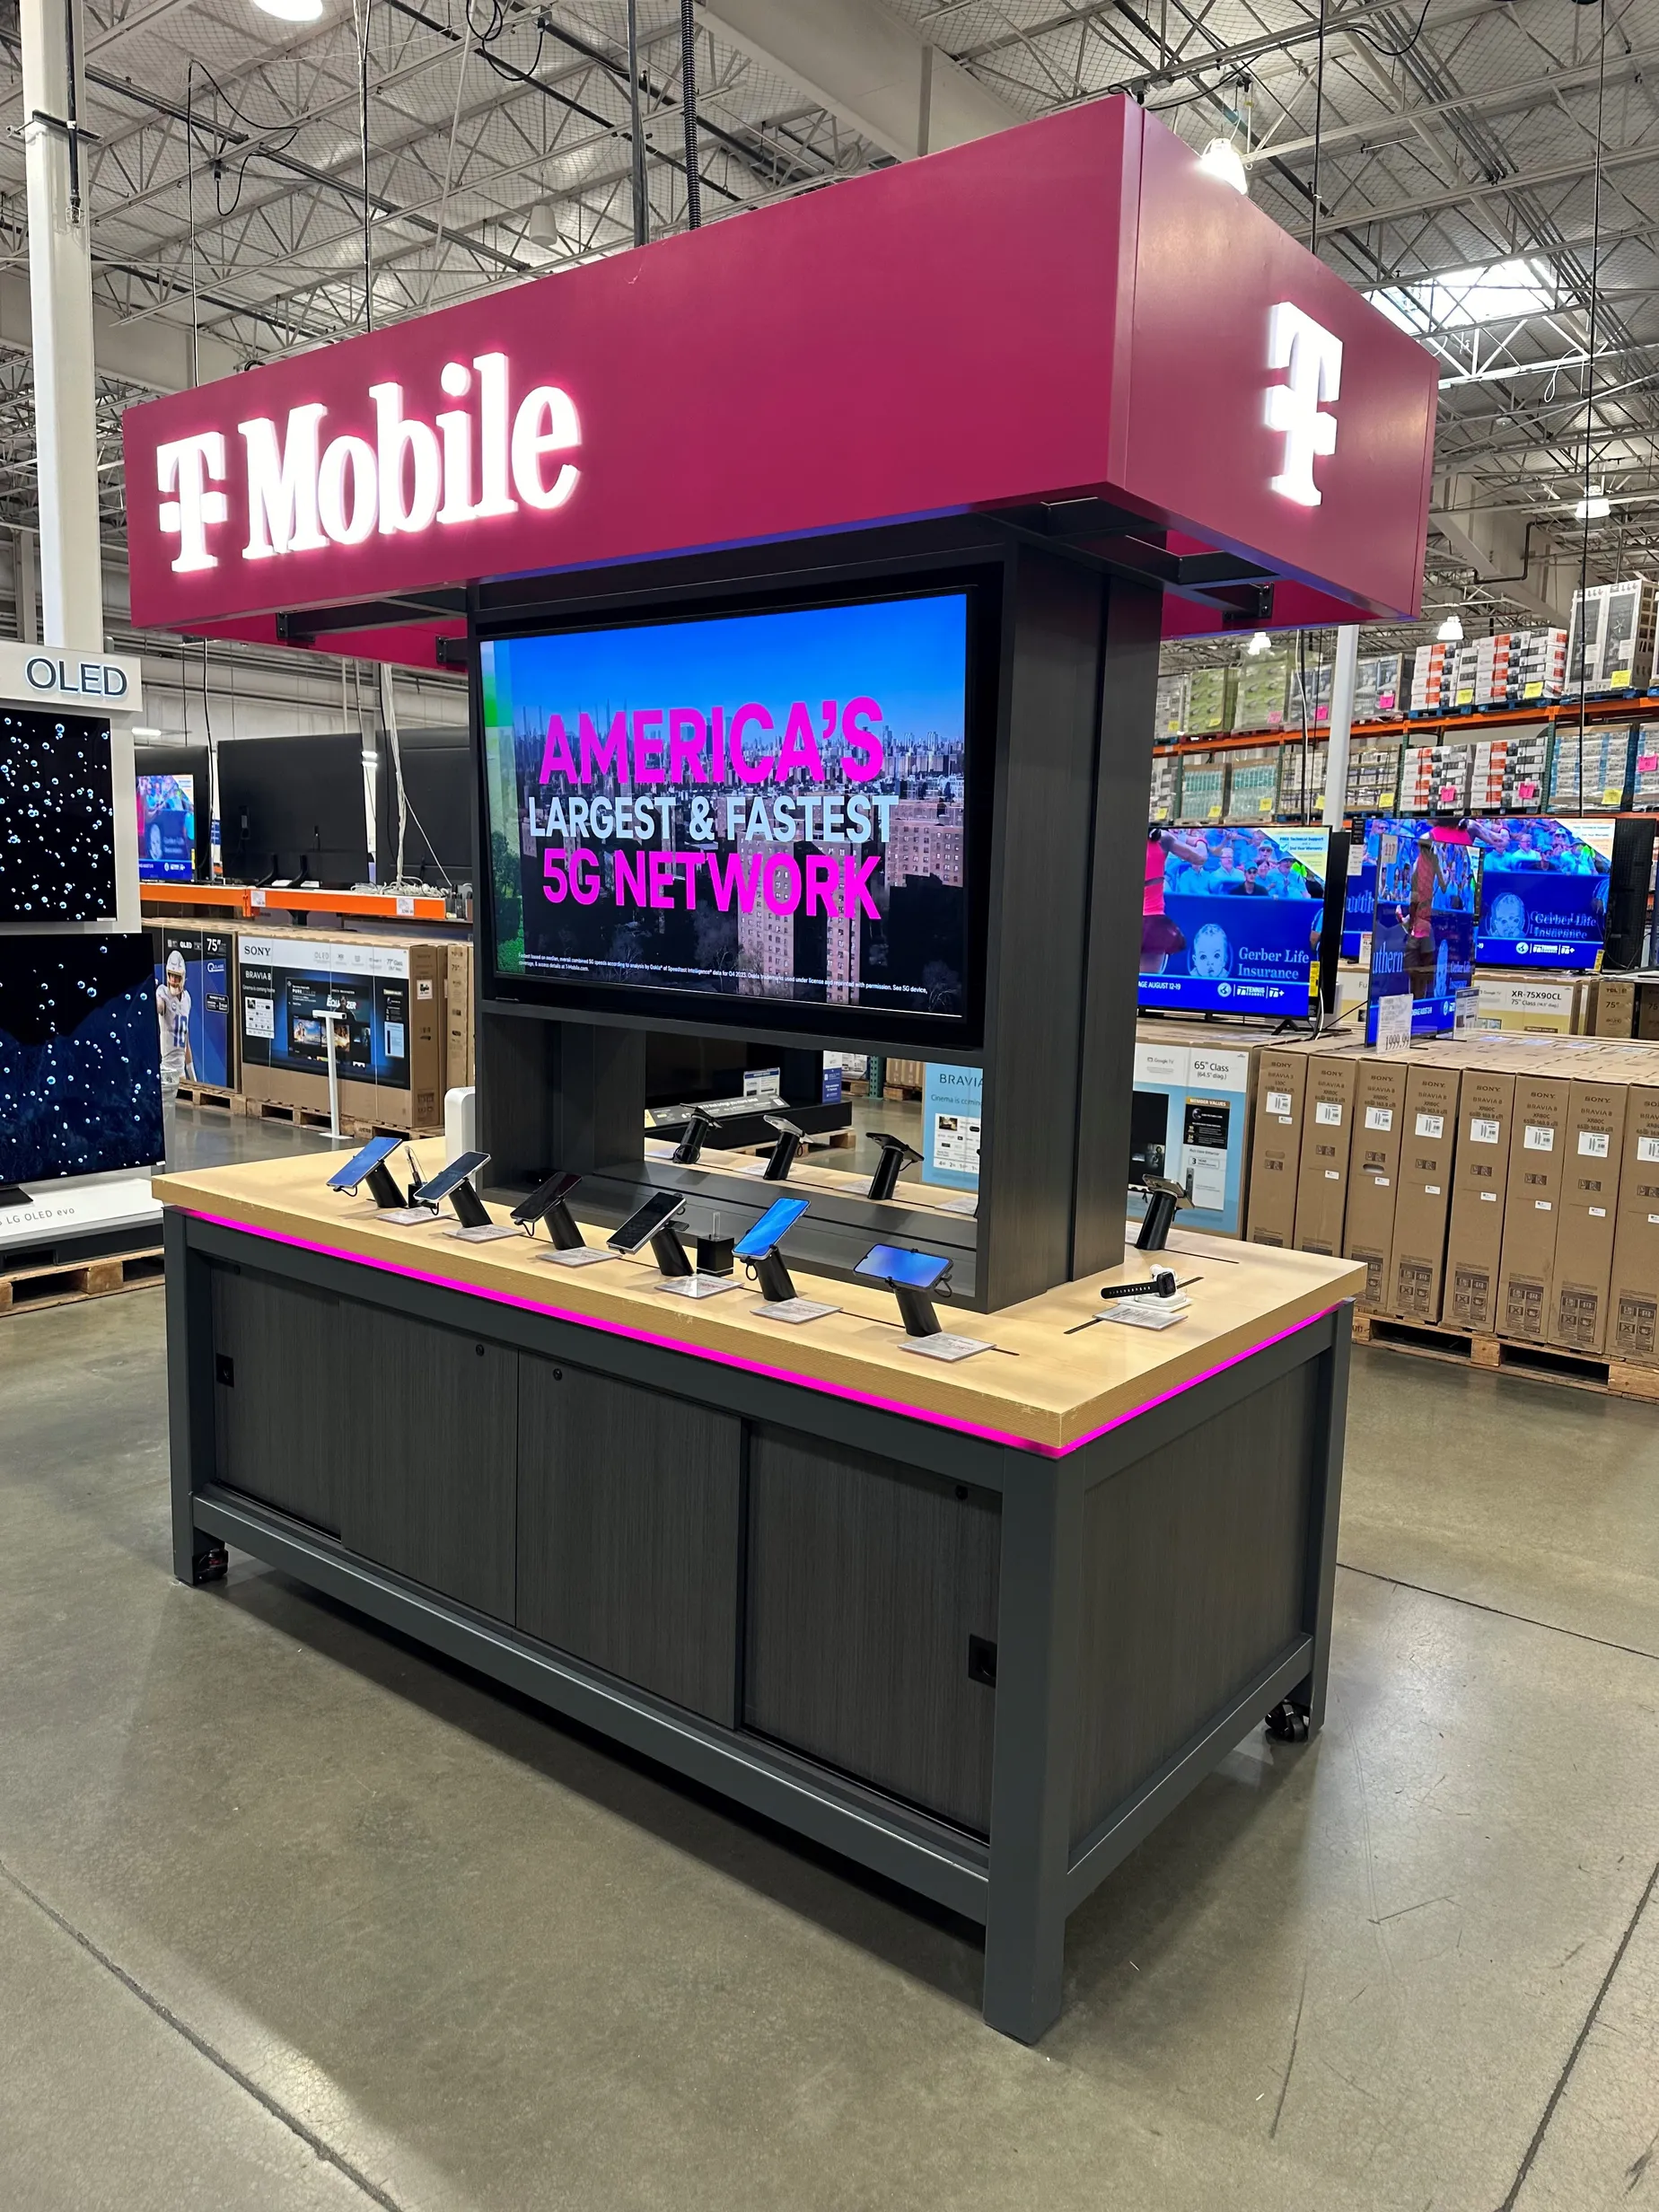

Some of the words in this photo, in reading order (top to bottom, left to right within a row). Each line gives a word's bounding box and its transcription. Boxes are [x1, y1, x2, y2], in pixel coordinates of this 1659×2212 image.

[26, 657, 127, 696] OLED
[539, 696, 883, 784] AMERICA'S
[529, 796, 676, 840] LARGEST
[689, 796, 715, 841] &
[727, 794, 899, 842] FASTEST
[542, 848, 601, 905] 5G
[616, 850, 882, 920] NETWORK
[244, 945, 271, 956] SONY
[1239, 947, 1282, 961] Gerber
[1284, 949, 1310, 963] Life
[245, 970, 268, 980] BRAVIA
[1238, 963, 1299, 979] Insurance
[1148, 981, 1169, 989] AUGUST
[1511, 990, 1562, 1000] XR-75X90CL
[1385, 1033, 1409, 1050] 1999.99
[1194, 1060, 1209, 1070] 65"
[1209, 1063, 1229, 1072] Class
[931, 1094, 953, 1103] Cinema
[954, 1096, 960, 1104] is
[961, 1098, 981, 1107] comin
[1527, 1103, 1552, 1111] BRAVIA
[1581, 1108, 1608, 1117] BRAVIA
[6, 1214, 21, 1224] LG
[24, 1209, 53, 1222] OLED
[57, 1207, 75, 1216] evo
